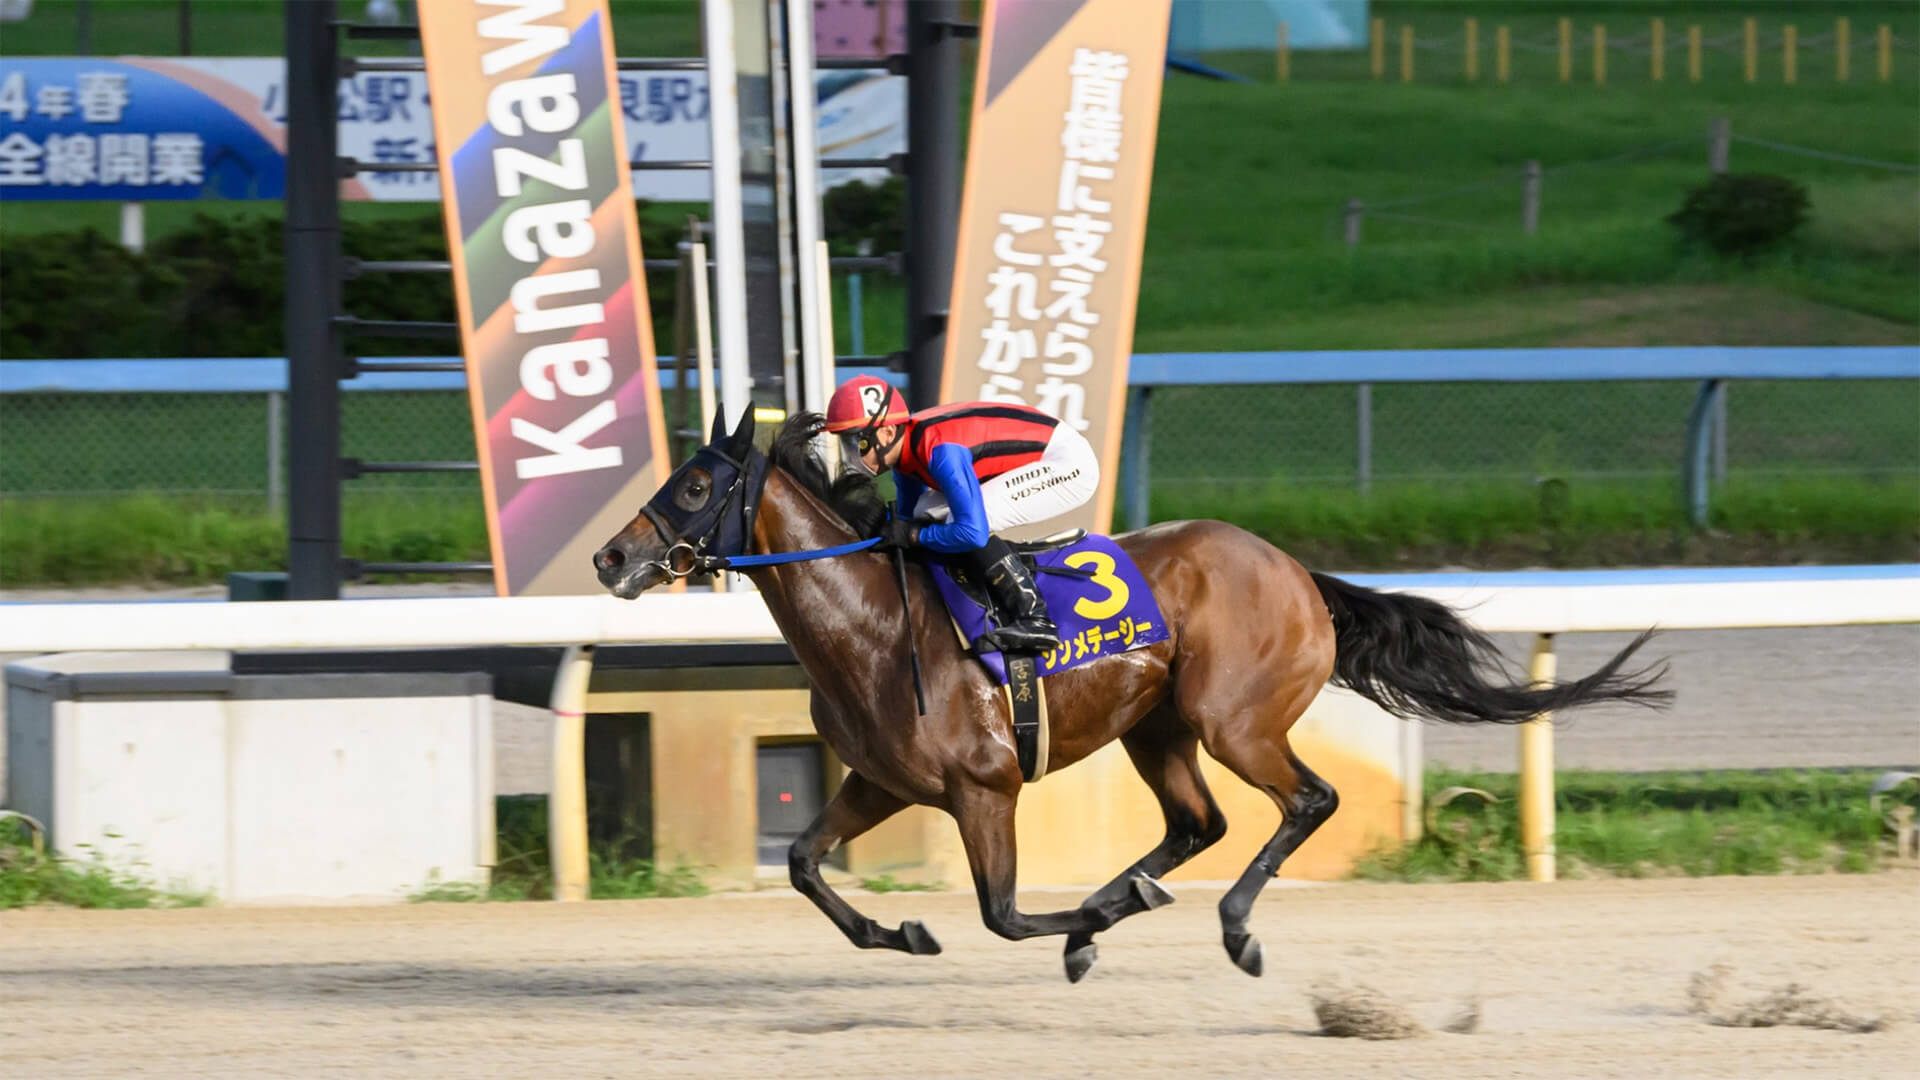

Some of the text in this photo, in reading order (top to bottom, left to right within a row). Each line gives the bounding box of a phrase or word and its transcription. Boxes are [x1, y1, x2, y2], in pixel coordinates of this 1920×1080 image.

[0, 132, 205, 185] 全線開業
[1034, 47, 1129, 431] 皆様に支えられ
[864, 386, 883, 418] 3
[1063, 551, 1130, 620] 3
